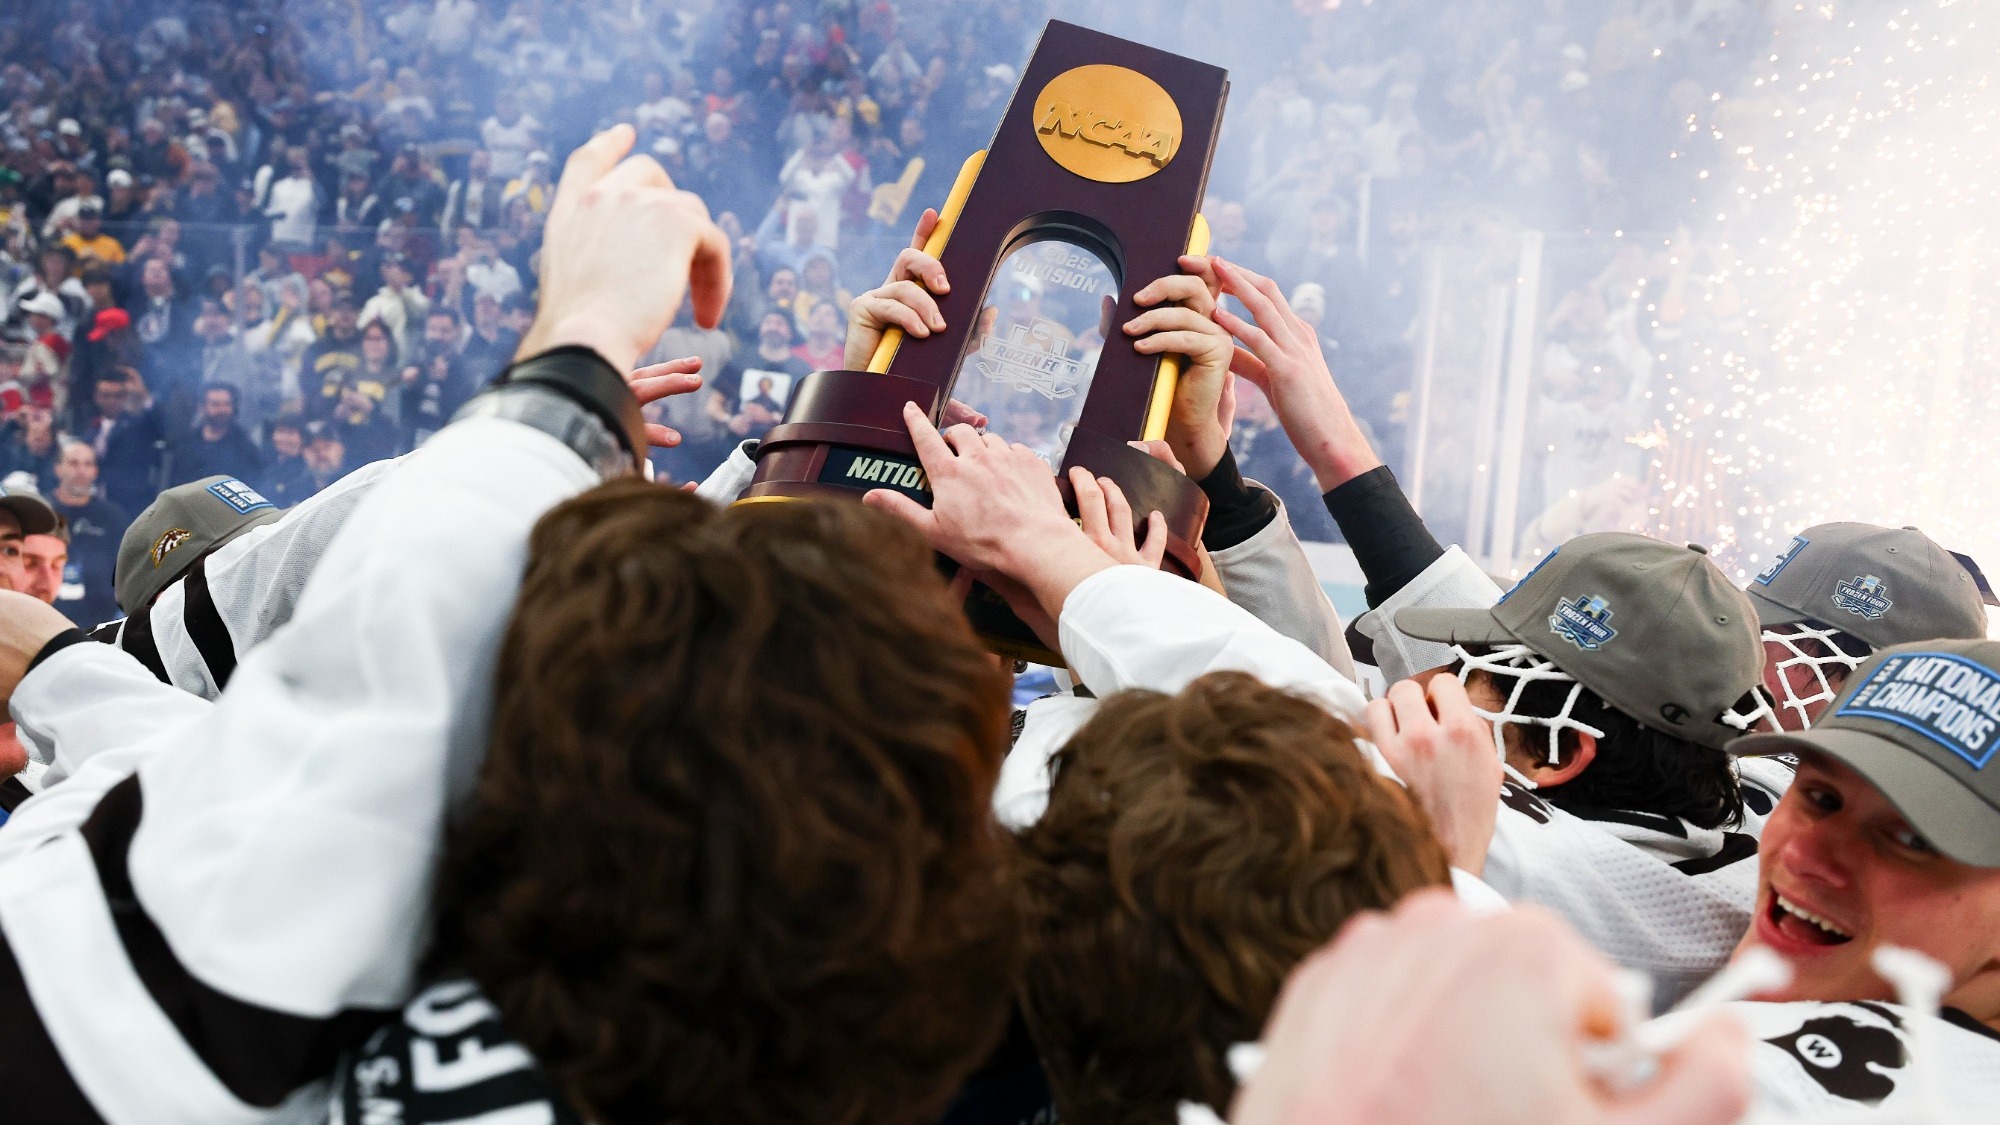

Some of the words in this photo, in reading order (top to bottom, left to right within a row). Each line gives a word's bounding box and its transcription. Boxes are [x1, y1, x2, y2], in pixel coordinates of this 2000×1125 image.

[1039, 101, 1174, 169] NCAA
[1013, 256, 1100, 294] DIVISION
[1045, 247, 1092, 271] 2025
[1840, 586, 1866, 602] FROZEN
[1866, 595, 1886, 609] FOUR
[1559, 605, 1589, 626] FROZEN
[1584, 619, 1608, 639] FOUR
[1868, 681, 1996, 751] CHAMPIONS
